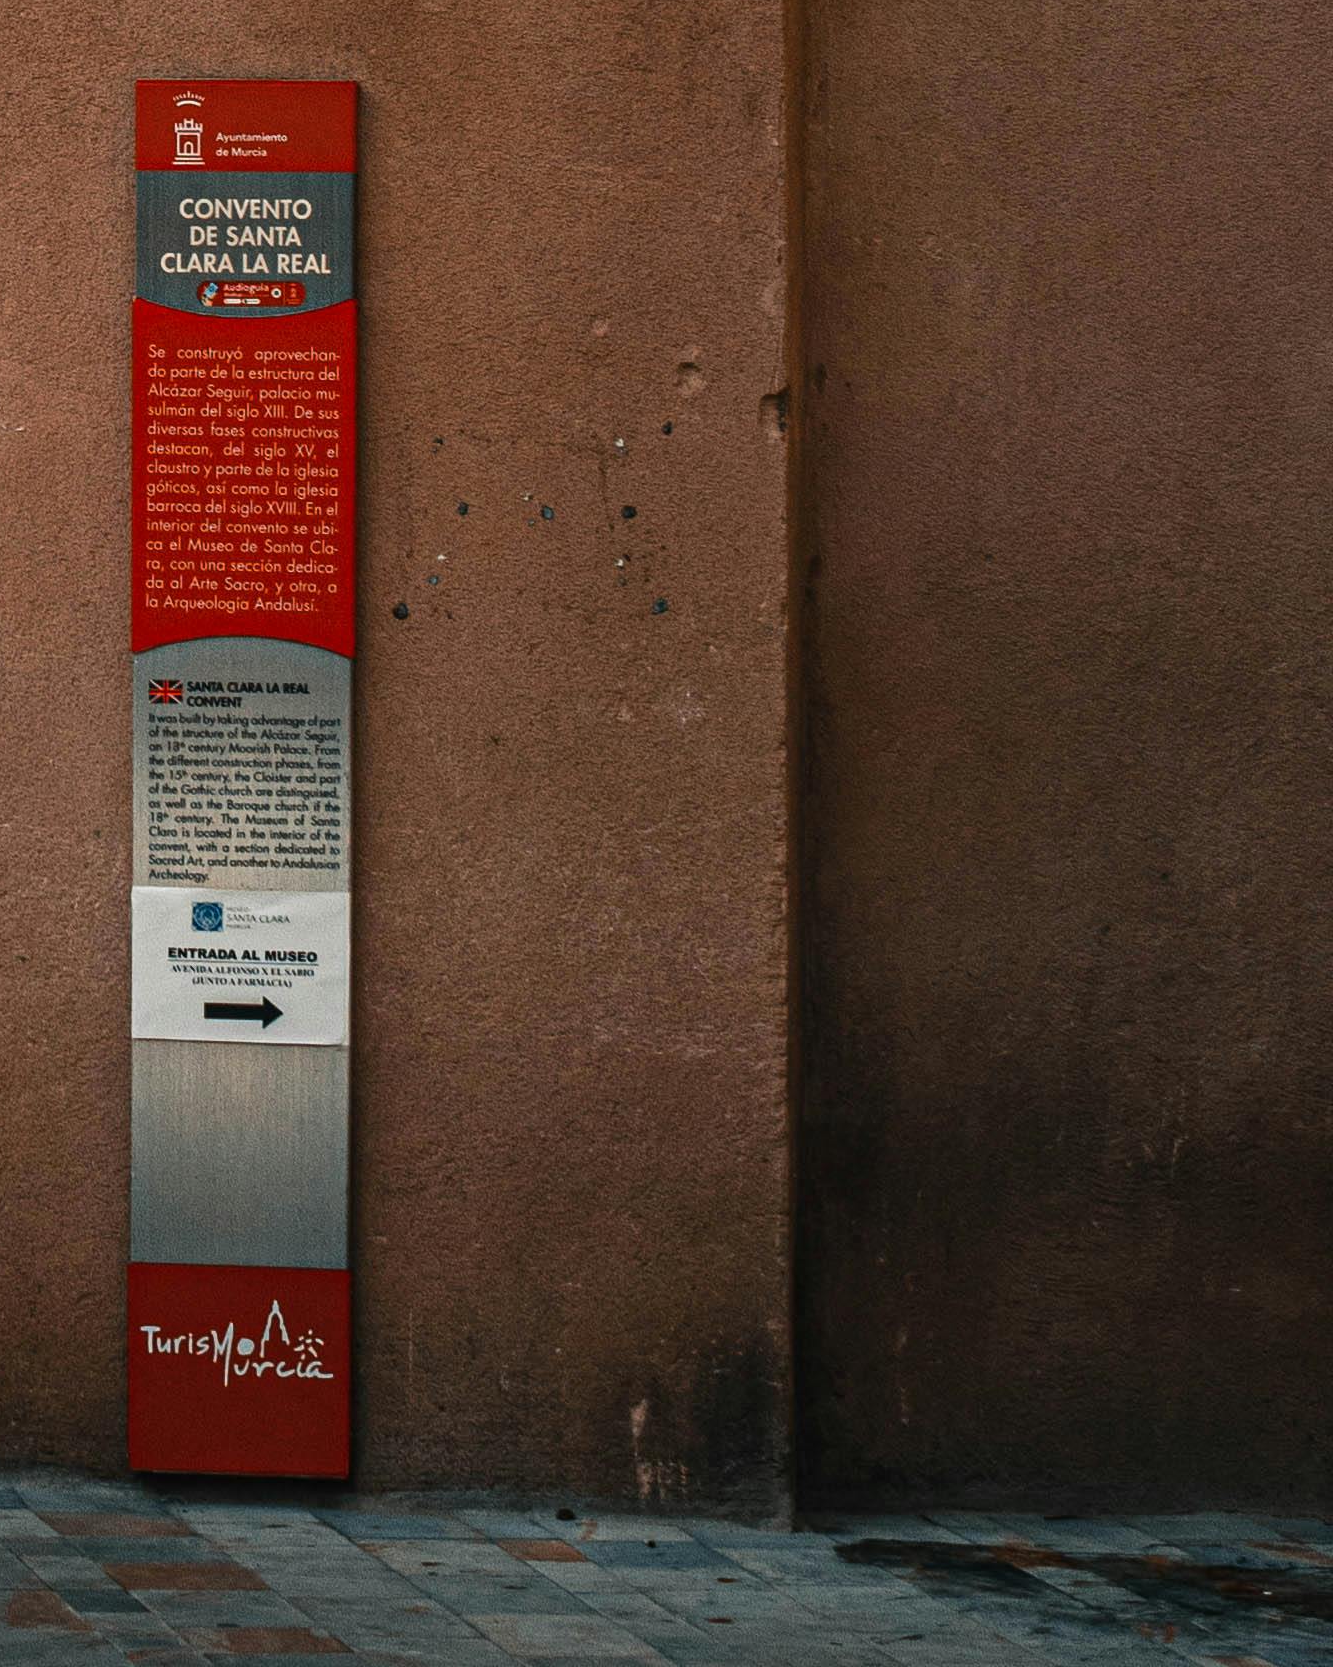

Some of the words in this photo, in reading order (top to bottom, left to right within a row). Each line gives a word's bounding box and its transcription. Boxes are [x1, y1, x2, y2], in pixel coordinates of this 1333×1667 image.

[215, 132, 288, 144] Ayuntamiento
[215, 147, 229, 157] de
[231, 147, 268, 157] Murcia
[179, 198, 313, 220] CONVENTO
[189, 226, 218, 246] DE
[226, 226, 302, 247] SANTA
[160, 253, 235, 274] CLARA
[242, 253, 270, 274] LA
[277, 253, 332, 275] REAL
[148, 343, 165, 359] Se
[177, 343, 243, 365] construyó
[254, 345, 340, 367] aprovechan-
[148, 362, 166, 378] do
[170, 362, 206, 383] parte
[210, 363, 227, 379] de
[232, 363, 244, 380] la
[248, 364, 314, 381] estructura
[318, 365, 339, 382] del
[148, 381, 201, 398] Alcázar
[207, 382, 253, 403] Seguir,
[259, 383, 311, 405] palacio
[316, 391, 339, 401] mu-
[148, 400, 195, 417] sulmán
[200, 401, 221, 418] del
[227, 402, 259, 423] siglo
[264, 403, 287, 419] XIII.
[295, 403, 313, 420] De
[318, 410, 339, 421] sus
[147, 420, 203, 437] diversas
[211, 421, 245, 438] fases
[252, 422, 339, 440] constructivas
[147, 439, 212, 458] destacan,
[223, 441, 244, 457] del
[254, 441, 286, 462] siglo
[295, 442, 316, 461] XV,
[327, 443, 339, 460] el
[147, 458, 200, 475] claustro
[204, 465, 212, 479] y
[216, 459, 252, 480] parte
[256, 460, 273, 477] de
[277, 461, 289, 477] la
[294, 461, 338, 483] iglesia
[147, 477, 199, 498] góticos,
[206, 478, 226, 495] así
[231, 485, 269, 496] como
[275, 480, 287, 496] la
[294, 480, 338, 502] iglesia
[147, 496, 201, 513] barroca
[205, 497, 226, 514] del
[231, 498, 262, 519] siglo
[267, 499, 300, 516] XVIII.
[306, 500, 322, 516] En
[326, 500, 338, 517] el
[147, 516, 194, 533] interior
[200, 517, 221, 534] del
[226, 518, 288, 535] convento
[294, 525, 308, 536] se
[313, 520, 338, 537] ubi-
[146, 541, 163, 551] ca
[170, 535, 181, 552] el
[188, 536, 234, 553] Museo
[240, 537, 257, 554] de
[264, 538, 303, 555] Santa
[310, 539, 338, 556] Cla-
[146, 560, 164, 572] ra,
[170, 560, 195, 571] con
[200, 561, 225, 572] una
[231, 556, 281, 573] sección
[286, 558, 337, 575] dedica-
[146, 573, 164, 589] da
[170, 573, 183, 590] al
[189, 574, 218, 591] Arte
[225, 575, 268, 594] Sacro,
[275, 582, 283, 596] y
[289, 577, 321, 595] otra,
[327, 584, 337, 594] a
[146, 592, 158, 608] la
[164, 592, 249, 615] Arqueología
[254, 595, 317, 613] Andalusí.
[187, 681, 224, 693] SANTA
[227, 682, 264, 693] CLARA
[266, 682, 280, 694] LA
[282, 682, 311, 694] REAL
[187, 696, 242, 708] CONVENT
[168, 947, 237, 960] ENTRADA
[241, 950, 260, 961] AL
[264, 950, 318, 962] MUSEO
[172, 965, 213, 974] AVENIDA
[215, 966, 260, 975] ALFONSO
[261, 967, 268, 976] X
[271, 968, 281, 976] EL
[284, 968, 315, 977] SABIO
[192, 977, 228, 986] (JUNTO
[230, 978, 236, 986] A
[237, 978, 293, 988] FARMACIA)
